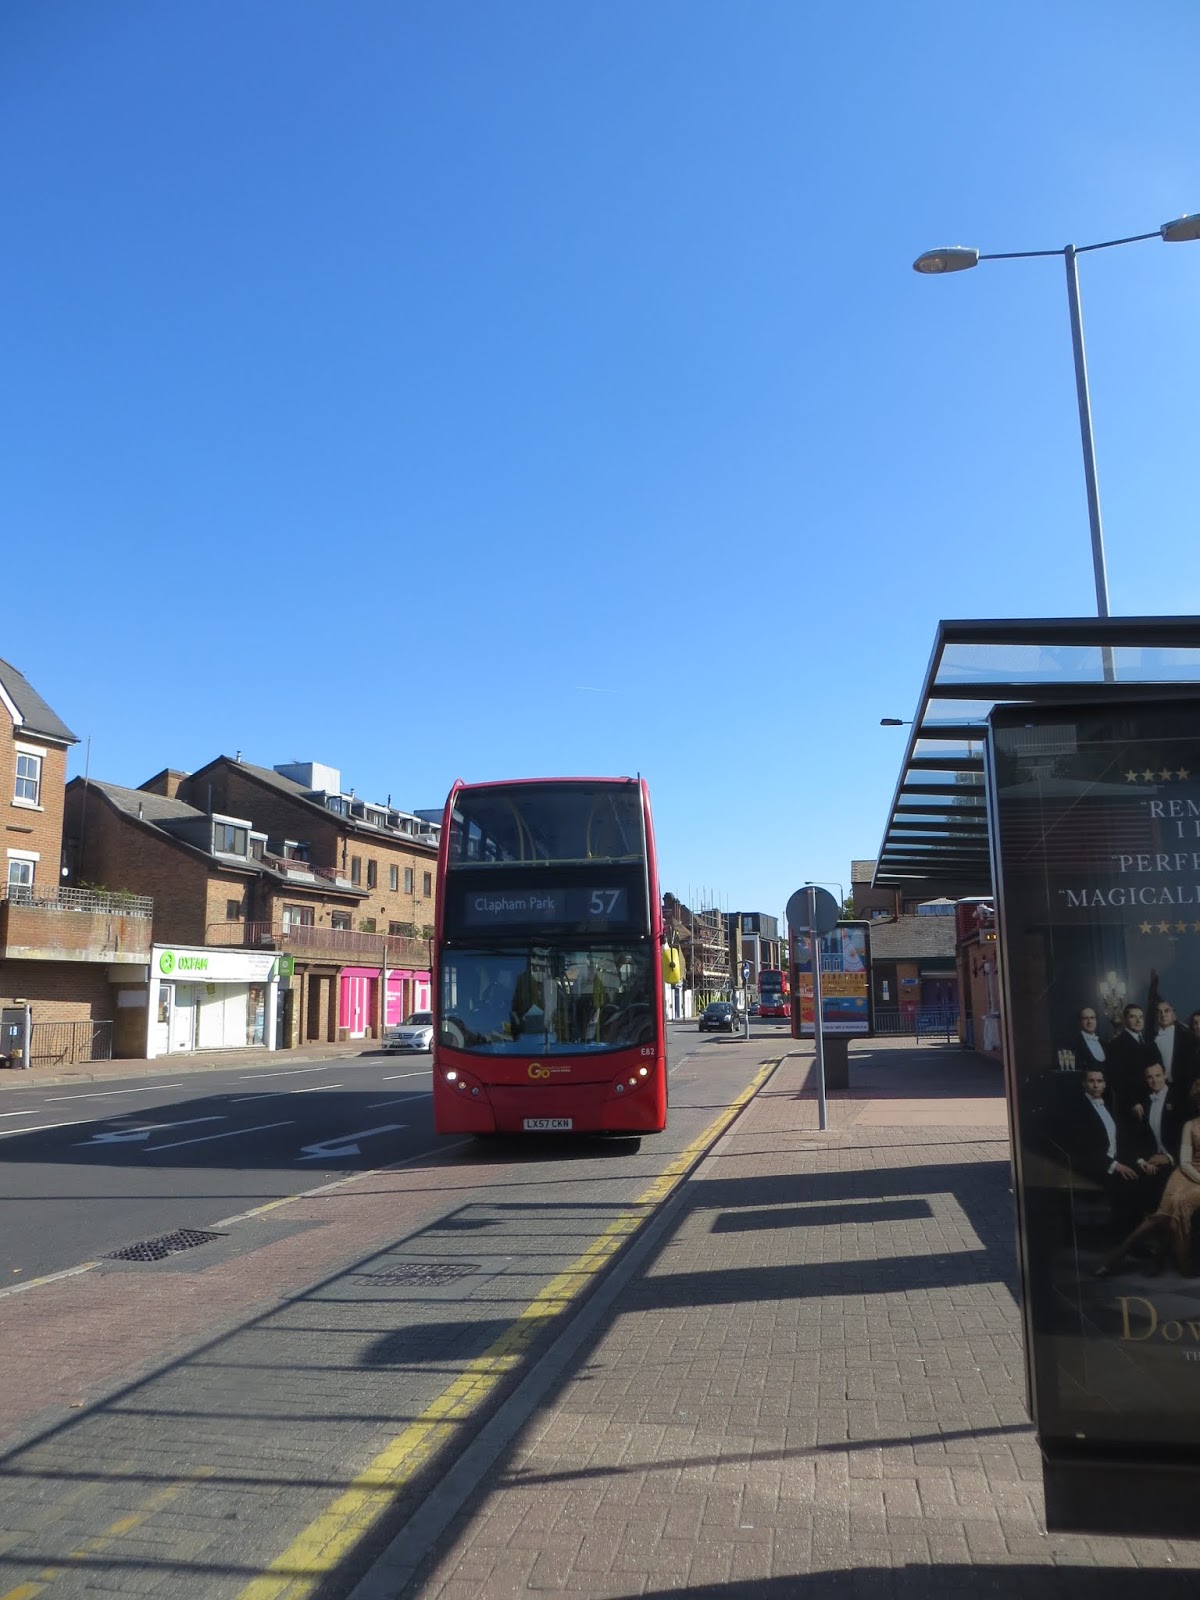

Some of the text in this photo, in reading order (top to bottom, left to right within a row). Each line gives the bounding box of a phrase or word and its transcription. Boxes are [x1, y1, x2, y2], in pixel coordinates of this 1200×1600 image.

[475, 896, 555, 915] Clapham Park
[589, 889, 621, 915] 57
[178, 956, 209, 971] OXFAM
[640, 1047, 655, 1056] E82
[527, 1119, 569, 1128] LX57 CKN
